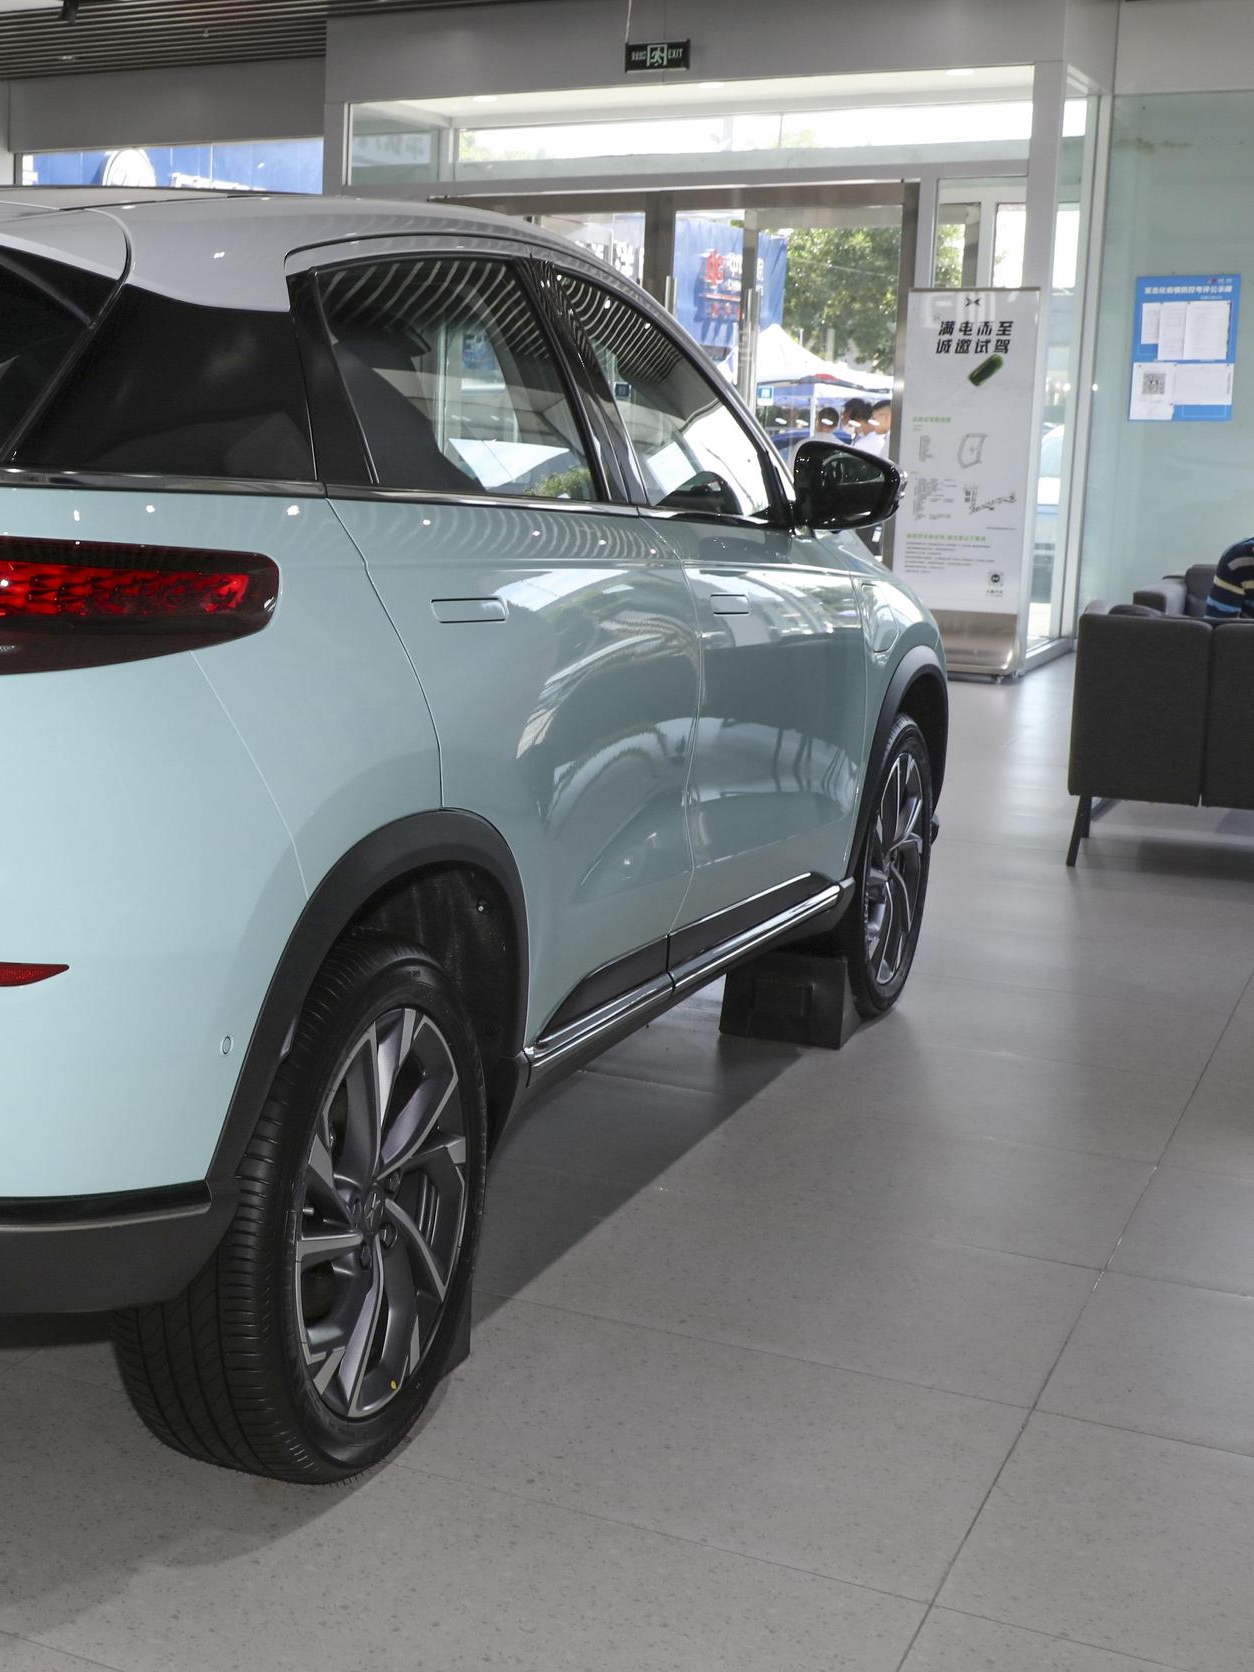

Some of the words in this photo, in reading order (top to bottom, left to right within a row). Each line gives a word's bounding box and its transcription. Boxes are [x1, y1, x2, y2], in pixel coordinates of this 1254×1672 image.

[668, 49, 683, 59] EXIT
[938, 320, 1014, 337] 满电而至
[935, 338, 1011, 355] 诚邀试驾
